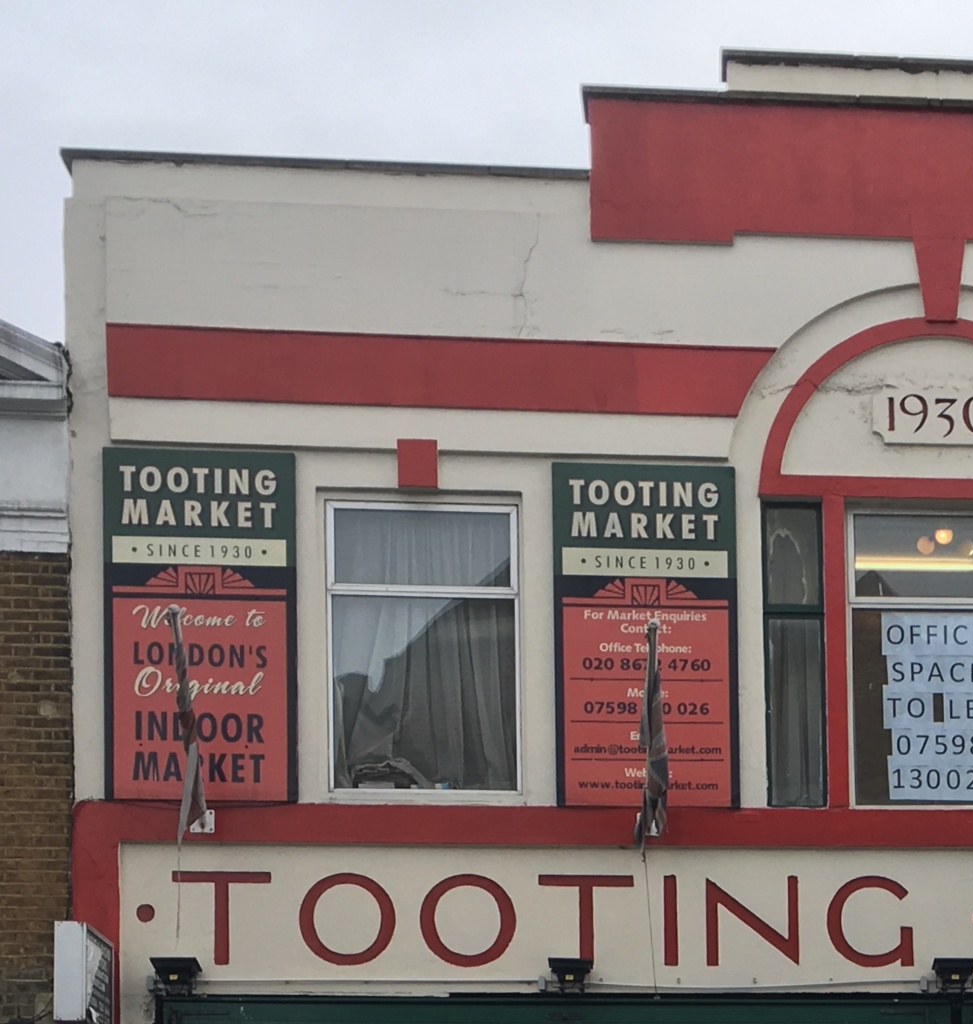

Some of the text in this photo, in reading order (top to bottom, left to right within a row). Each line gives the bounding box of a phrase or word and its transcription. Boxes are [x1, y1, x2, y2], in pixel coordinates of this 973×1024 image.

[119, 465, 277, 495] TOOTING
[568, 478, 719, 508] TOOTING
[121, 499, 277, 528] MARKET
[570, 511, 719, 540] MARKET
[146, 543, 253, 559] SINCE 1930
[594, 555, 696, 570] SINCE 1930
[132, 604, 265, 629] Wlcome to
[583, 609, 707, 623] For Market Enquiries
[620, 623, 672, 634] Contct:
[599, 642, 692, 654] Office Telphone:
[582, 657, 614, 670] 020
[668, 659, 711, 672] 4760
[583, 701, 638, 714] 07598
[677, 702, 710, 715] 026
[887, 697, 926, 718] TO
[132, 751, 265, 783] MAKET
[171, 870, 914, 967] TOOTING
